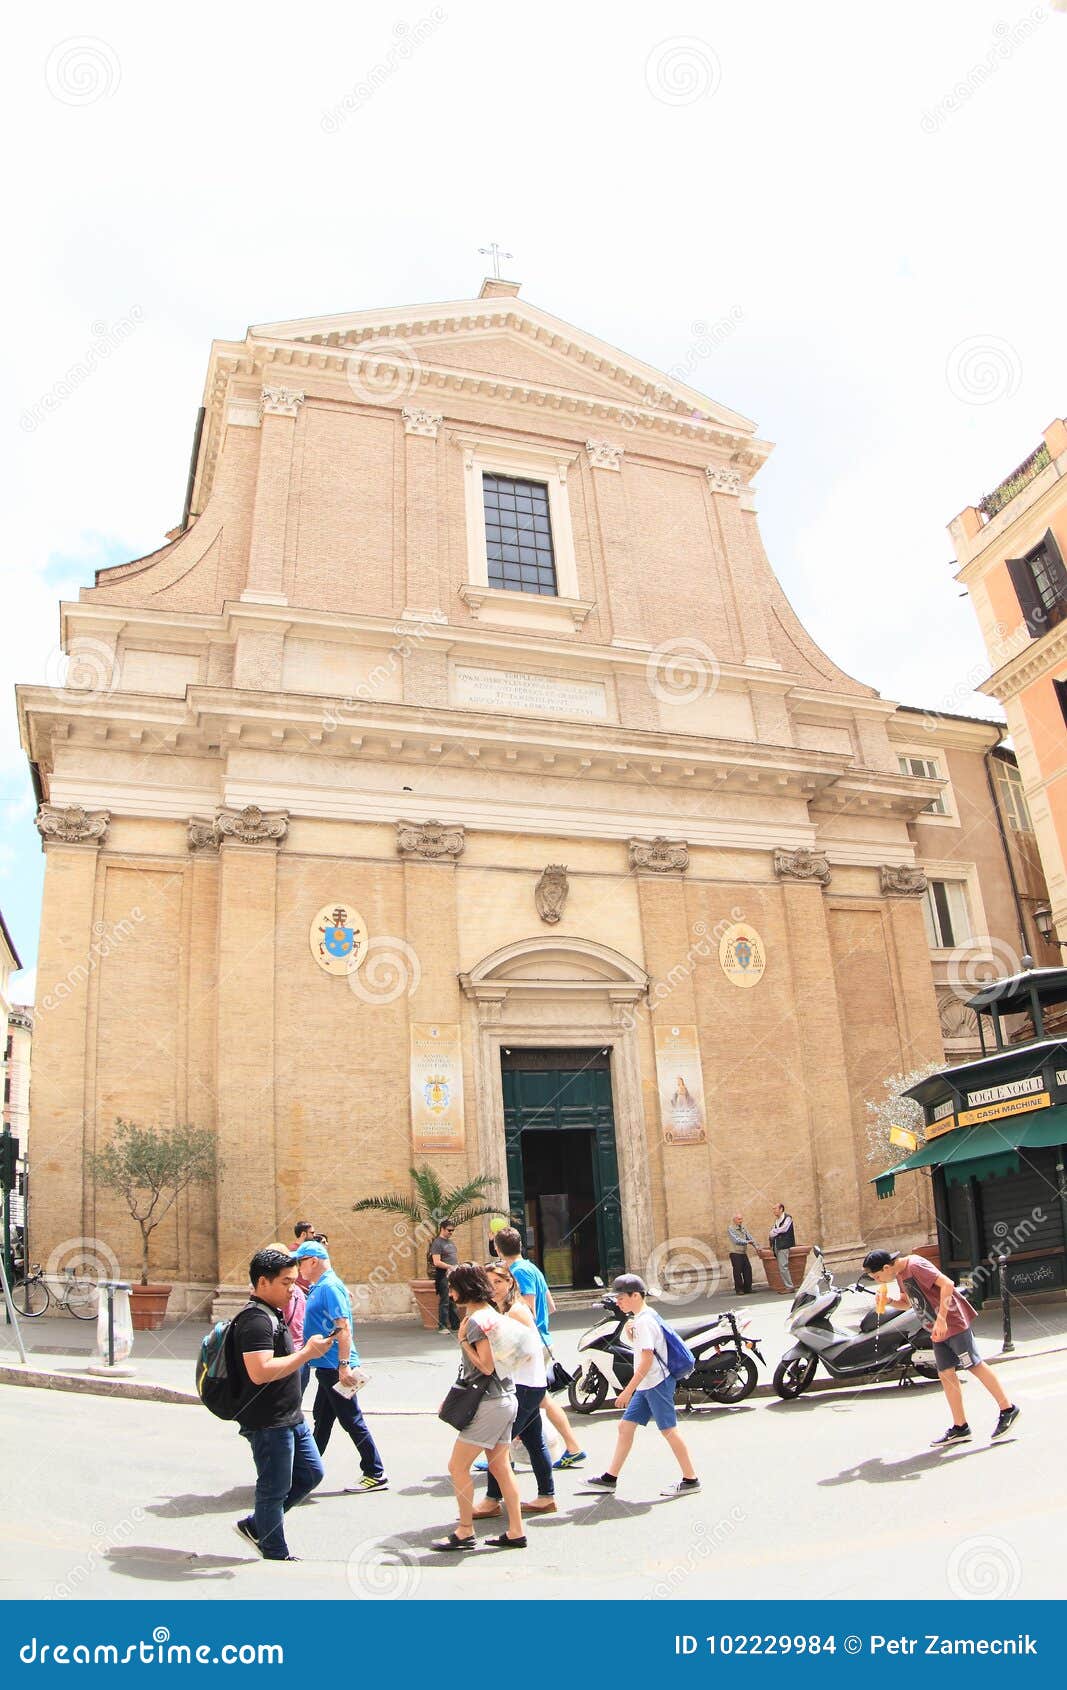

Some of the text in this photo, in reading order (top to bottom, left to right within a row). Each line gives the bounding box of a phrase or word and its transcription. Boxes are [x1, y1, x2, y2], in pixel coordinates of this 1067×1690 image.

[968, 1078, 1043, 1105] VOGUE VOGUE
[976, 1098, 1042, 1119] CASH MACHINE
